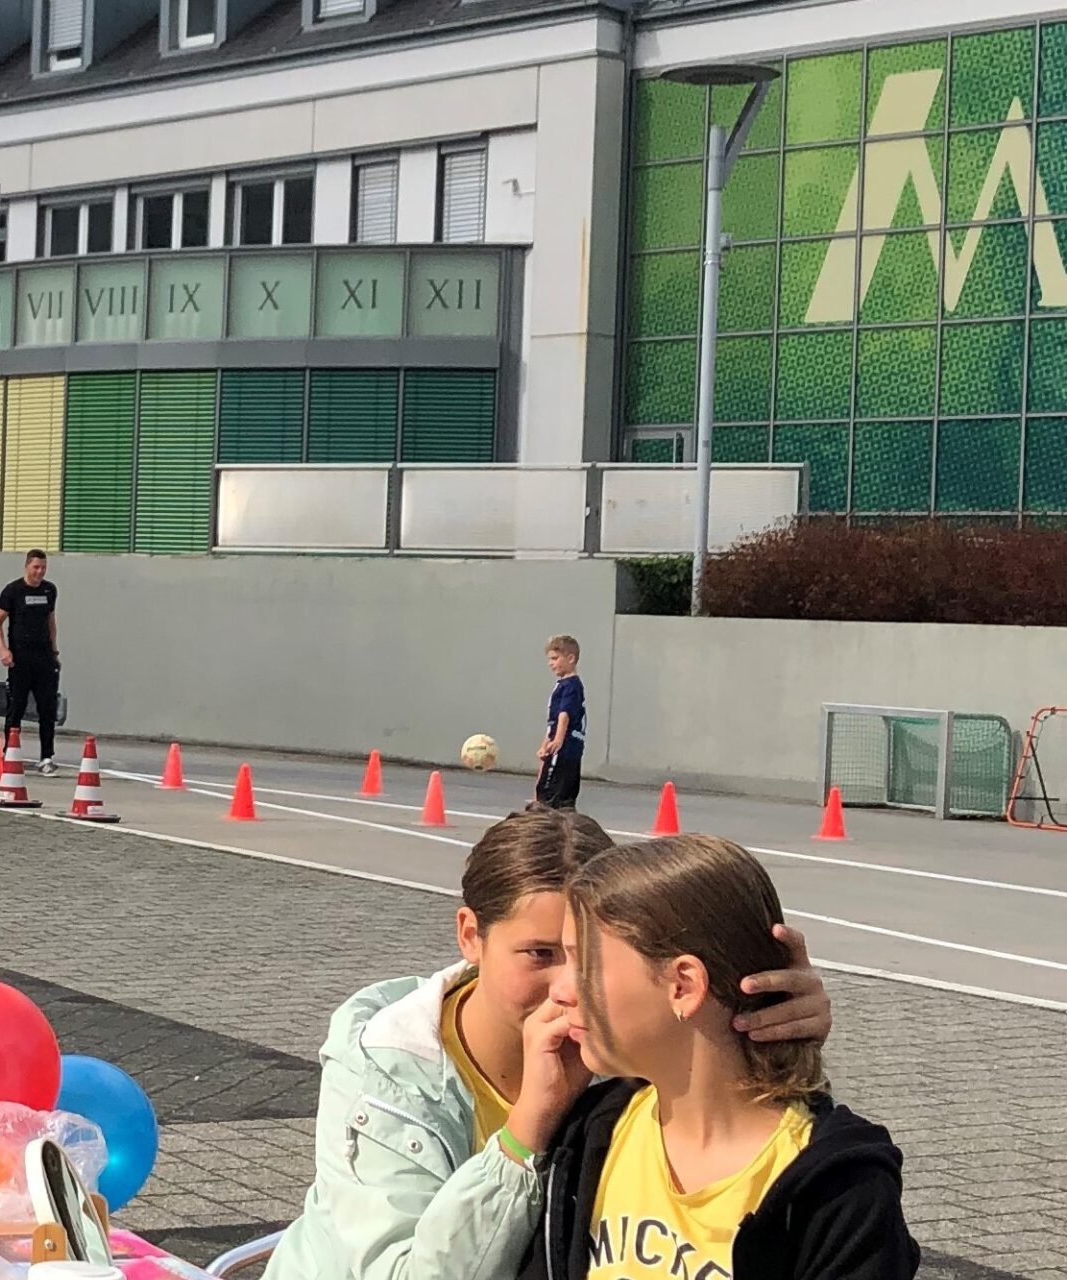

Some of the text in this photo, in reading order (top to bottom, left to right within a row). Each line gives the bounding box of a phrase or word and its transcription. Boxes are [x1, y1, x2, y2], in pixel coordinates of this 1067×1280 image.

[27, 289, 64, 320] VII
[85, 285, 138, 316] VIII
[168, 282, 202, 314] IX
[258, 280, 280, 311] X
[341, 278, 378, 310] XI
[425, 278, 482, 310] XII
